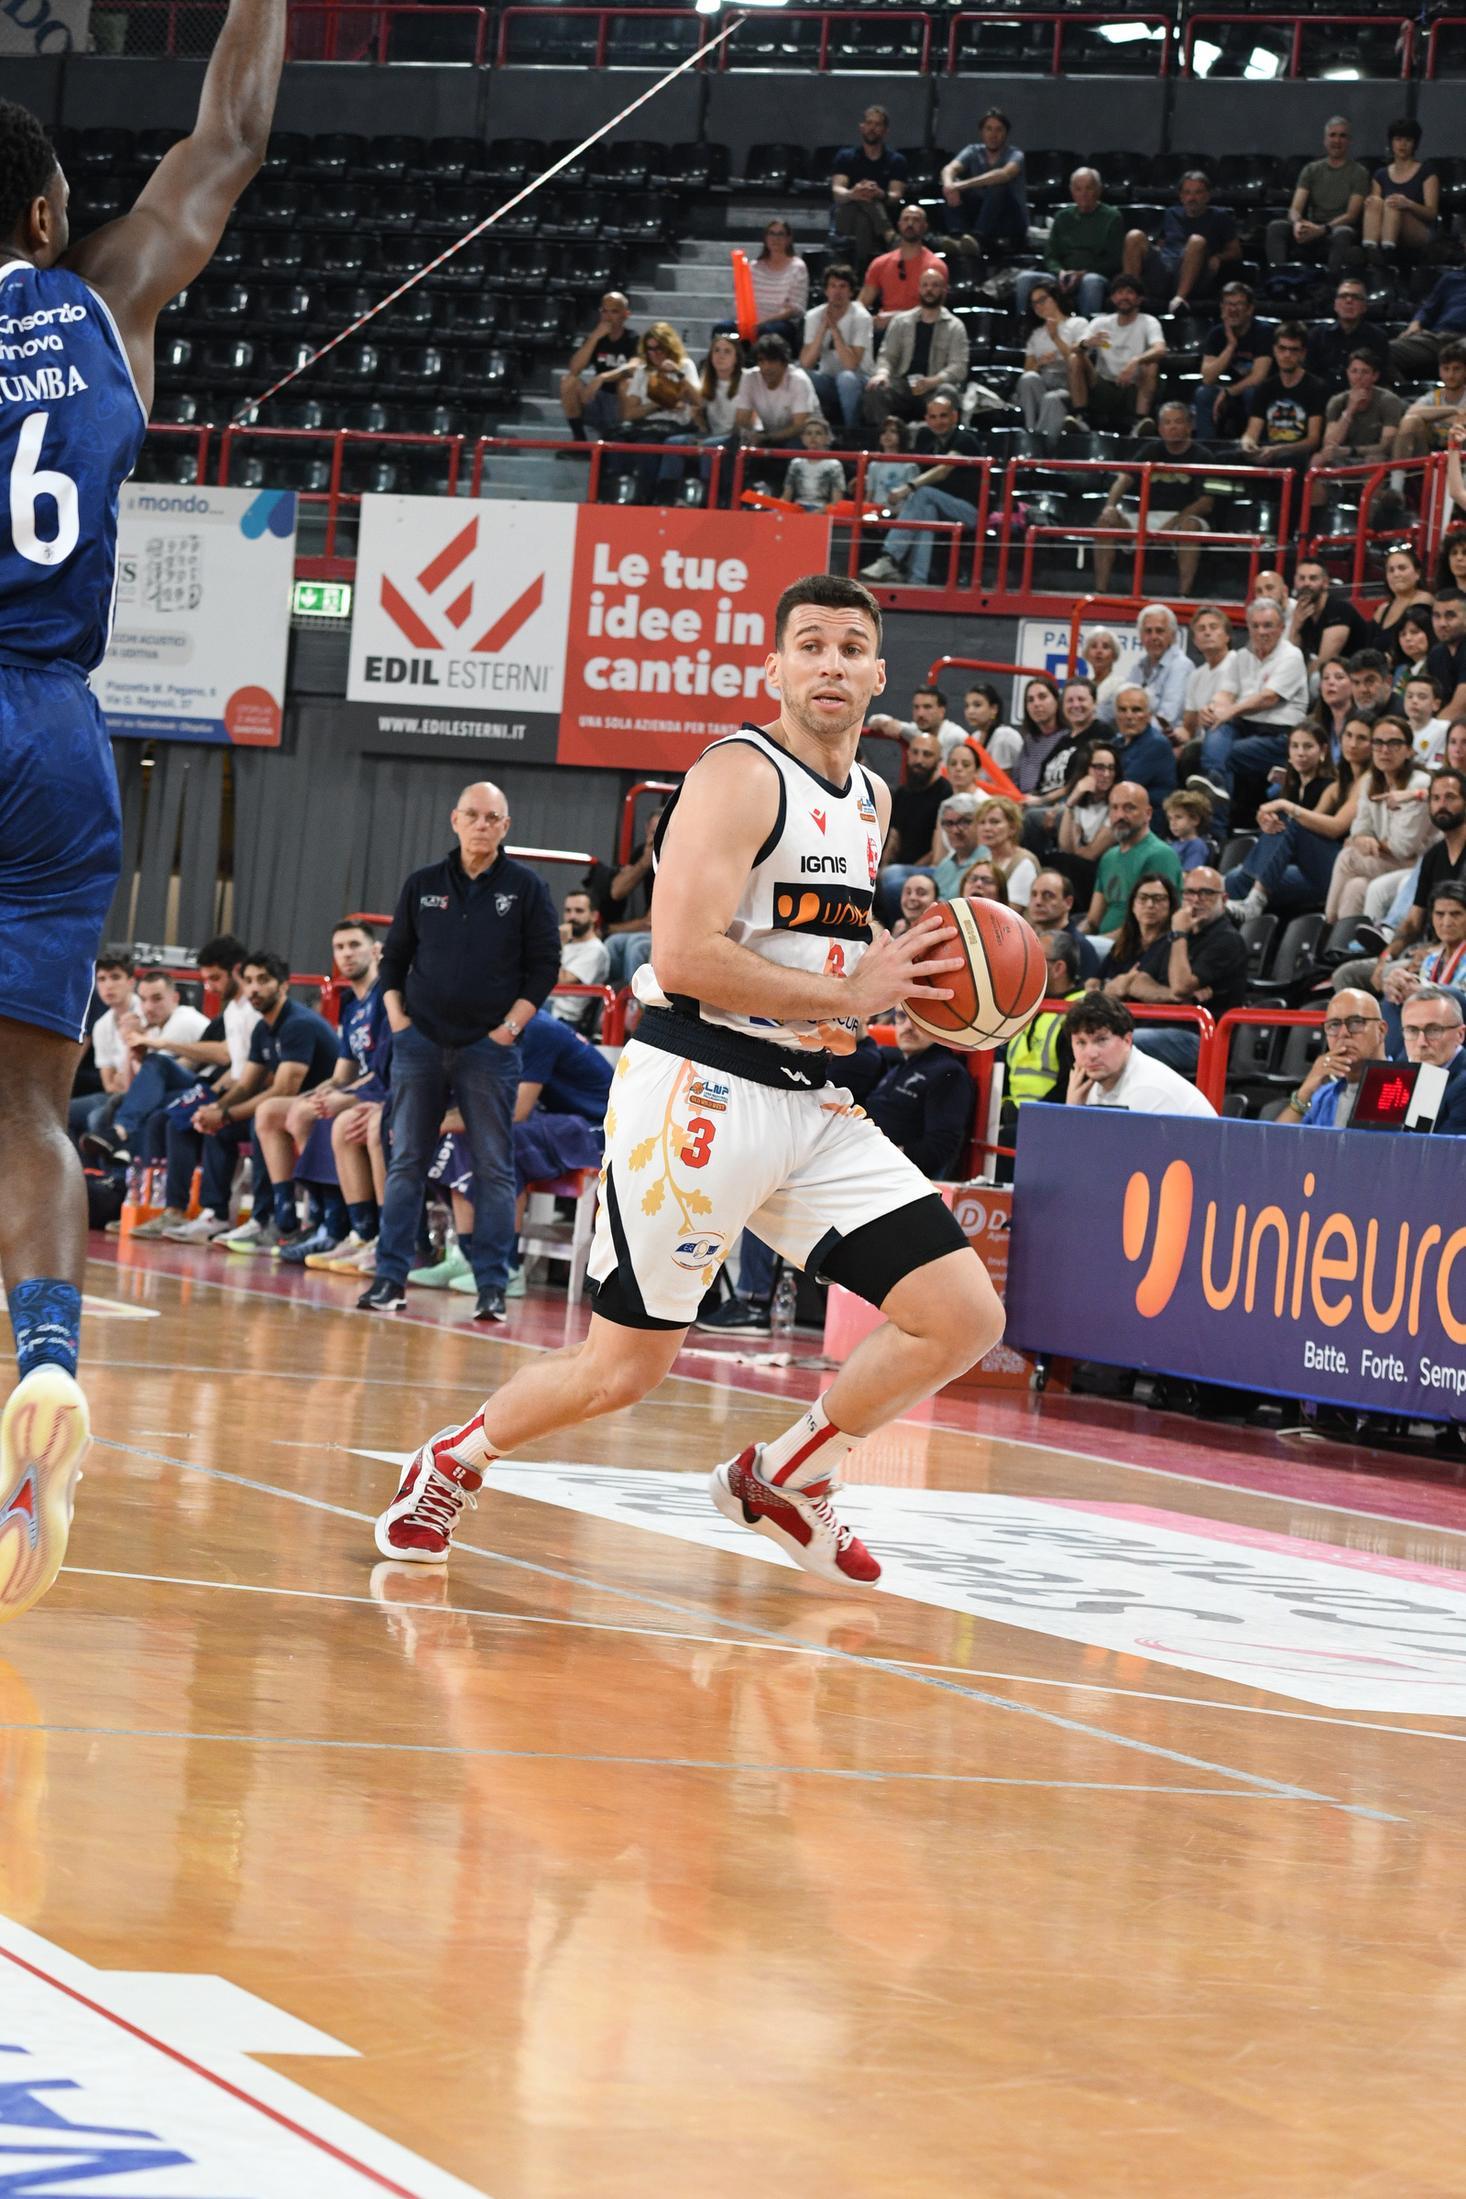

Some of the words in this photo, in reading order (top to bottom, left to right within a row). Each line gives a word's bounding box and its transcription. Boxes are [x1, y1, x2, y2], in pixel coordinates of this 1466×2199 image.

[0, 365, 88, 404] UMBA
[10, 412, 79, 566] 6
[592, 543, 649, 588] Le
[661, 550, 748, 593] tue
[587, 591, 702, 643] idee
[715, 597, 765, 646] in
[364, 656, 440, 686] EDIL
[447, 660, 549, 693] ESTERNI
[378, 716, 527, 740] WWW.EDILESTERNI.IT
[704, 1081, 729, 1096] LNP
[680, 1116, 716, 1169] 3
[1304, 1341, 1349, 1374] Batte.
[1361, 1349, 1408, 1382] Forte.
